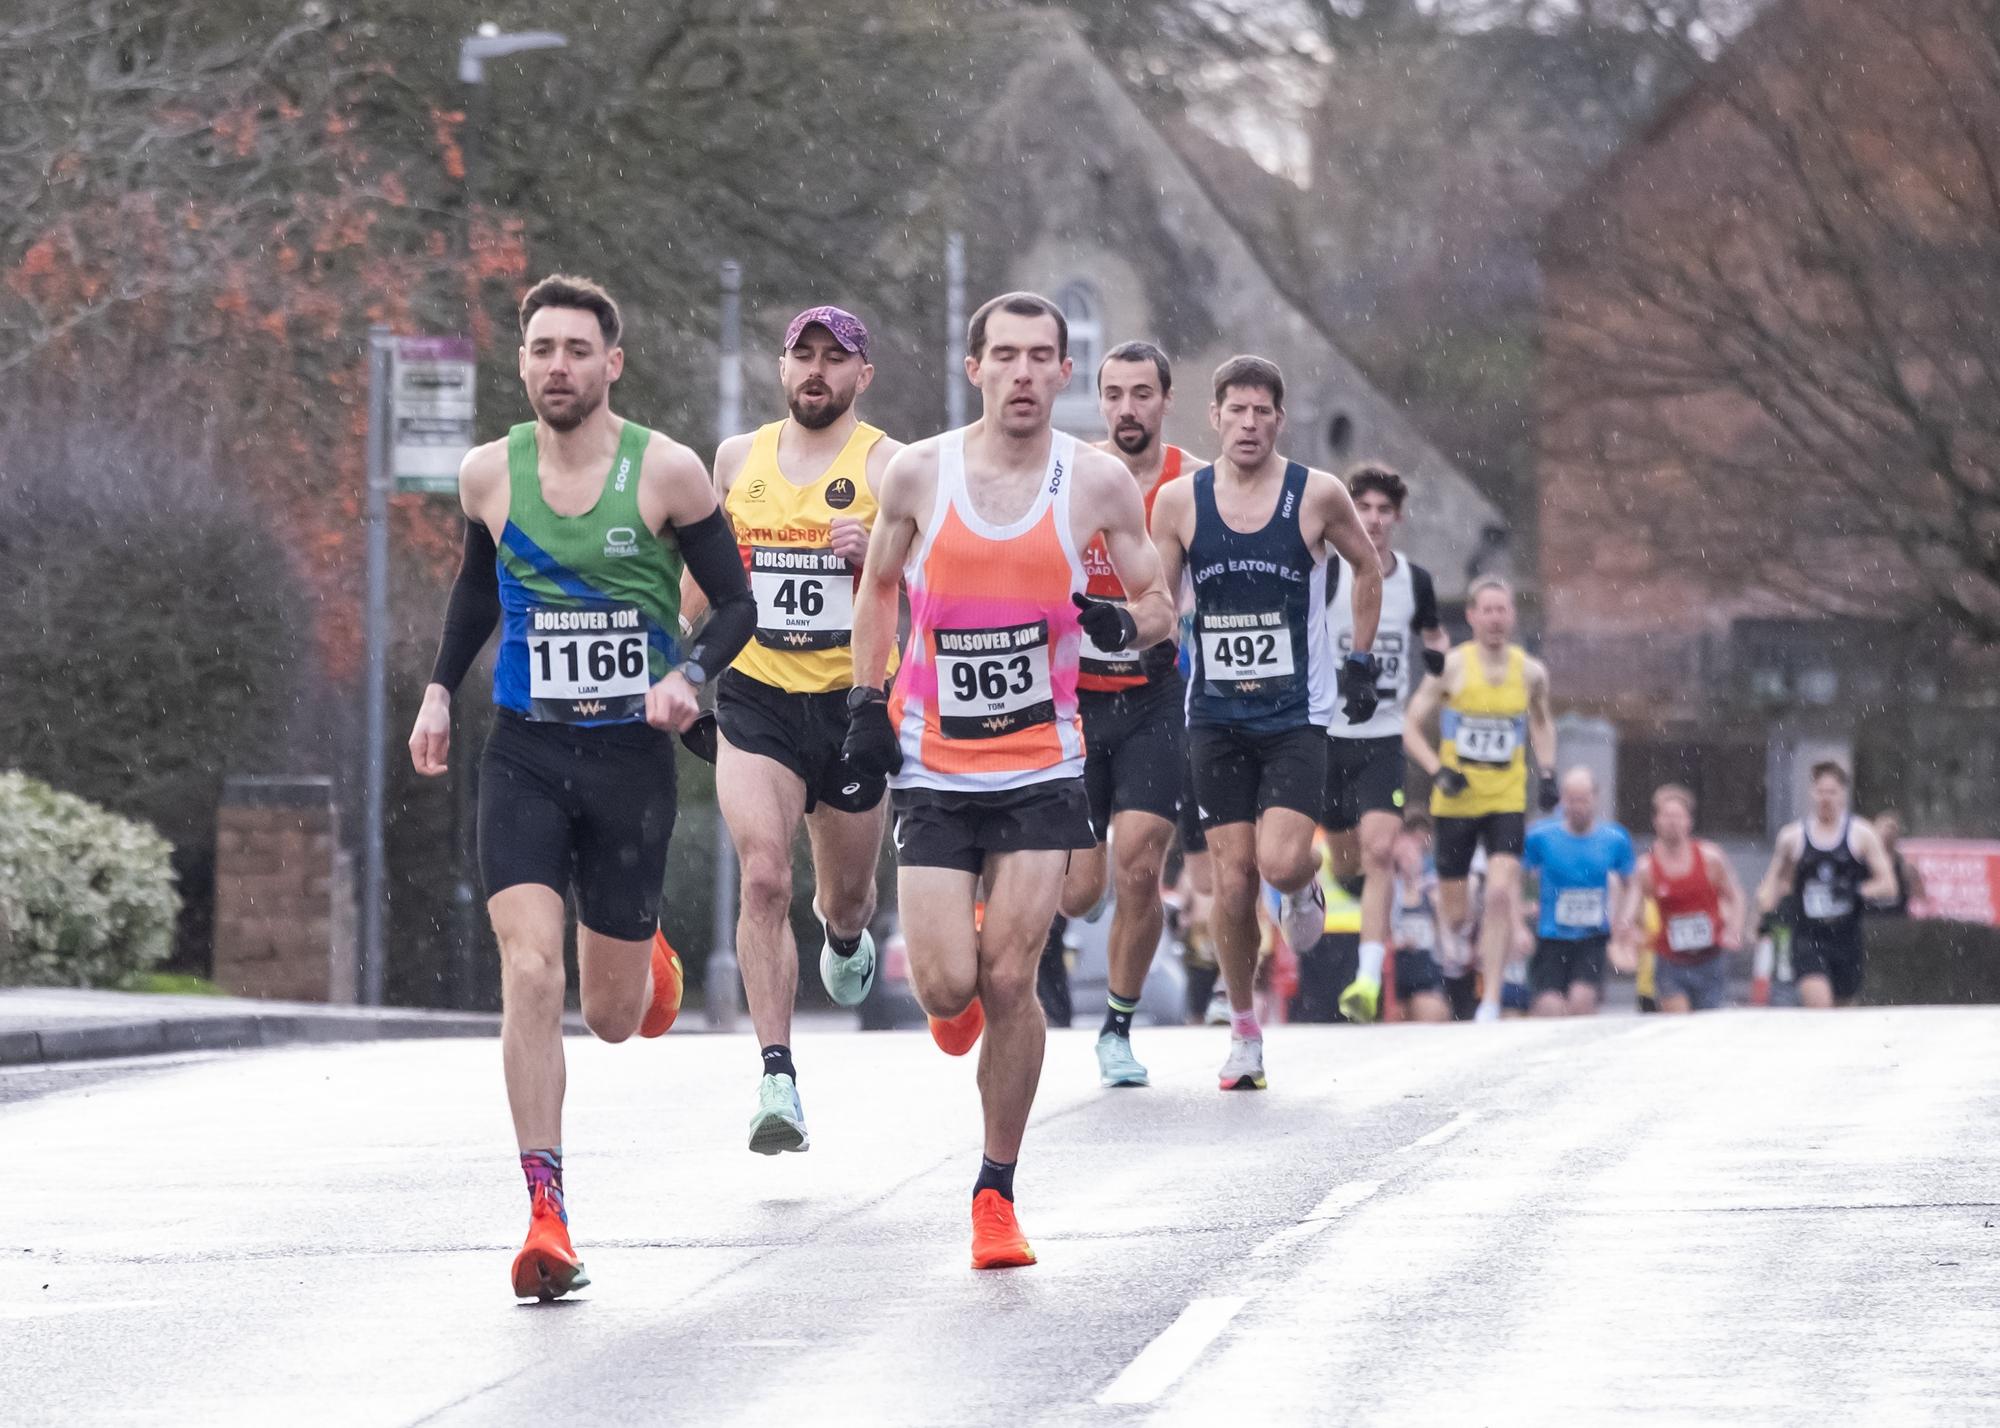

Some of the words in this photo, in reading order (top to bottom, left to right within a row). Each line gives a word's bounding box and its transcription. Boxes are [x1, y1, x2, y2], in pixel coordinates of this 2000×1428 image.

[614, 457, 631, 493] soar
[1049, 460, 1064, 495] soar
[1282, 490, 1295, 519] soar
[755, 552, 818, 569] BOLSOVER
[1195, 563, 1225, 585] LONG
[1228, 560, 1277, 574] EATON
[773, 579, 824, 616] 46
[534, 612, 608, 630] BOLSOVER
[610, 609, 639, 628] 10K
[786, 619, 811, 627] DANNY
[1204, 614, 1258, 629] BOLSOVER
[1260, 612, 1281, 626] 10K
[941, 632, 1011, 651] BOLSOVER
[1013, 626, 1040, 646] 10K
[1214, 634, 1278, 667] 492
[534, 638, 644, 682] 1166
[578, 686, 598, 694] LIAM
[952, 655, 1033, 701] 963
[987, 702, 1005, 711] TOM
[1465, 733, 1505, 752] 474
